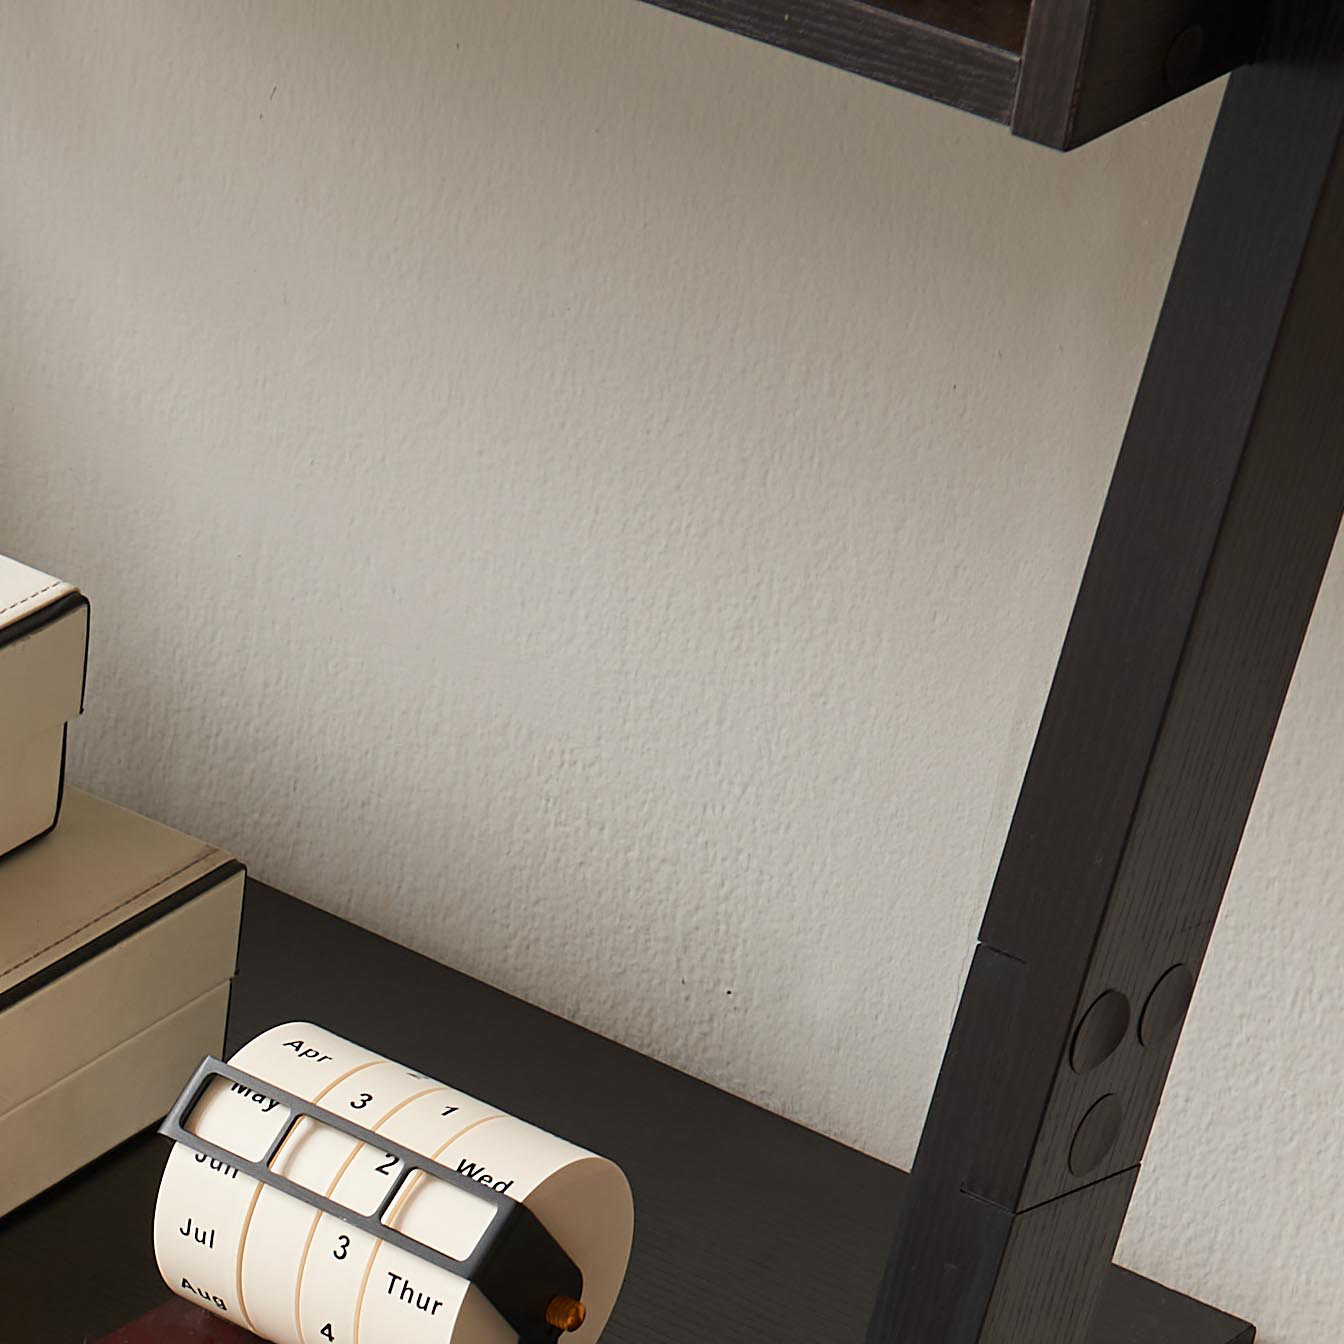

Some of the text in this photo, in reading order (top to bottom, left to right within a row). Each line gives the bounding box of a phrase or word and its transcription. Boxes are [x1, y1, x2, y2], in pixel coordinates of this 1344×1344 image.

[282, 1040, 333, 1063] Apr
[230, 1082, 281, 1113] May
[349, 1093, 374, 1110] 3
[440, 1105, 460, 1117] 1
[374, 1153, 400, 1176] 2
[455, 1158, 514, 1195] Wed
[179, 1217, 216, 1249] Jul
[333, 1234, 351, 1260] 3
[387, 1271, 443, 1316] Thur
[319, 1322, 335, 1343] 4
